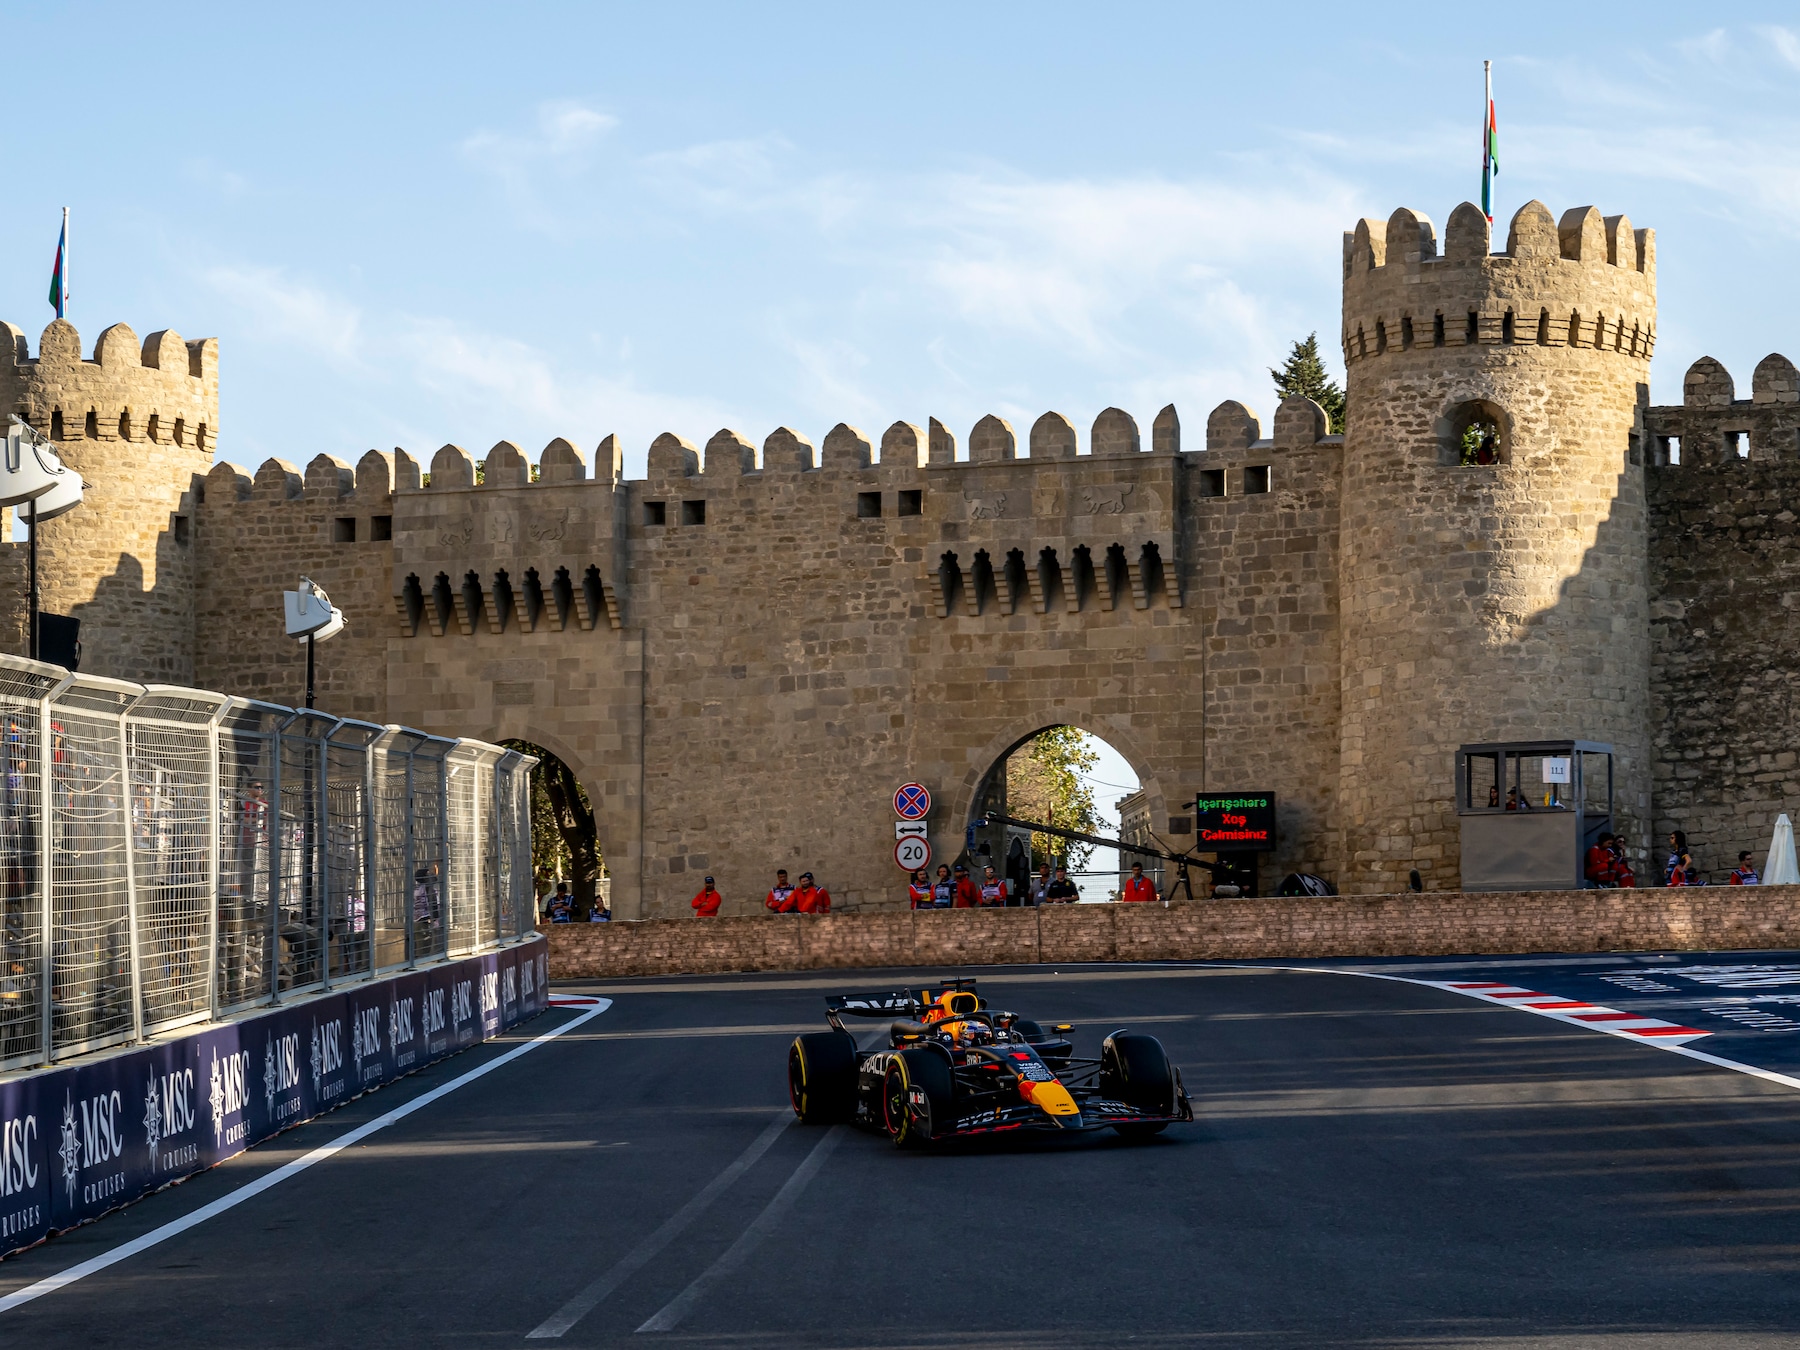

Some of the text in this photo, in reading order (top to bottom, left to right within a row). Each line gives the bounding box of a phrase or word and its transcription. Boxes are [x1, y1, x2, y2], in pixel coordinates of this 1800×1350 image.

[1221, 813, 1247, 827] Xoş
[903, 846, 923, 860] 20
[362, 1006, 381, 1057] MSC
[396, 997, 414, 1045] MSC
[276, 1032, 299, 1093] MSC
[321, 1019, 343, 1075] MSC
[162, 1068, 195, 1138] MSC
[223, 1050, 250, 1115] MSC
[81, 1090, 123, 1168] MSC
[226, 1119, 250, 1145] CRUISES
[163, 1143, 198, 1171] CRUISES
[84, 1171, 125, 1204] CRUISES
[2, 1204, 40, 1237] RUISES
